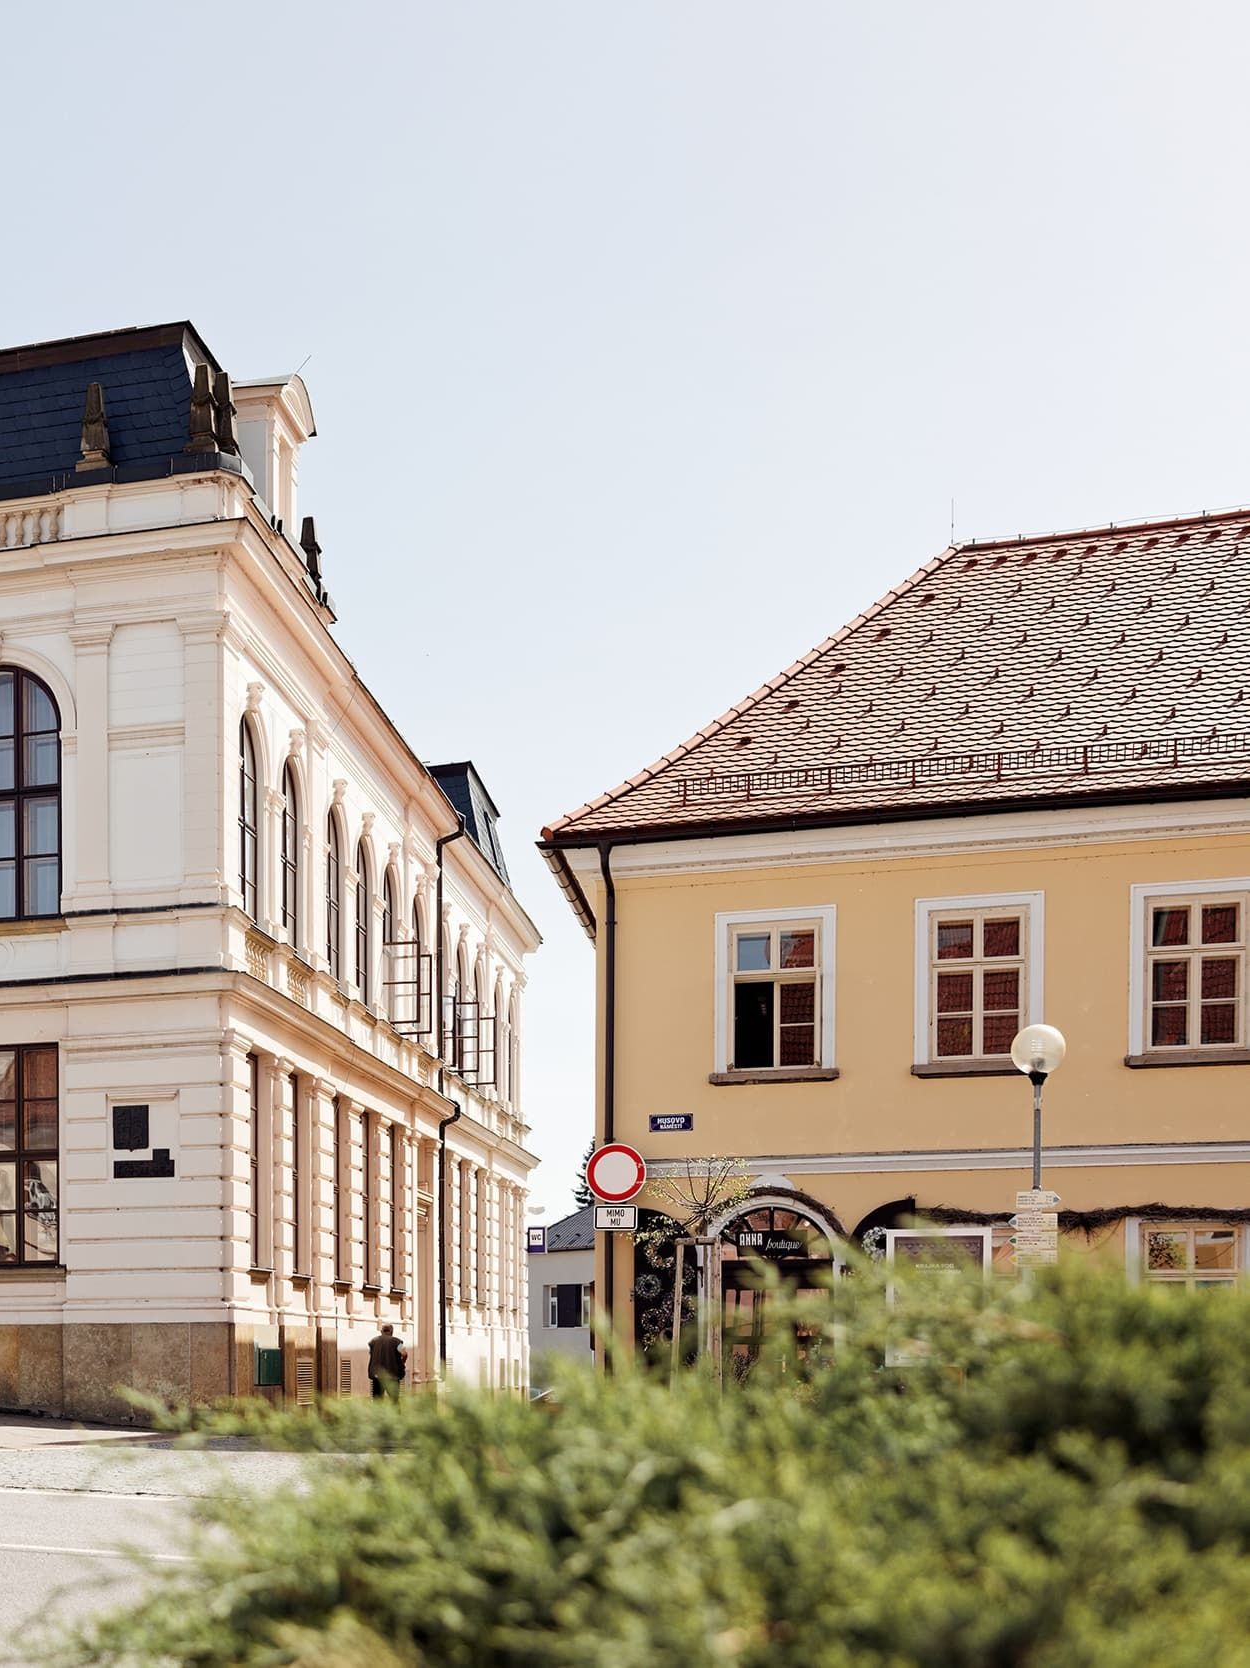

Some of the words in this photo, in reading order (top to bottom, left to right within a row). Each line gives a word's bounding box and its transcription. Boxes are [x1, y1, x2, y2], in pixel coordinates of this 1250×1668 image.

[606, 1209, 625, 1217] MIMO
[610, 1218, 621, 1226] MU
[739, 1233, 763, 1246] ANNA
[765, 1238, 803, 1251] boutique
